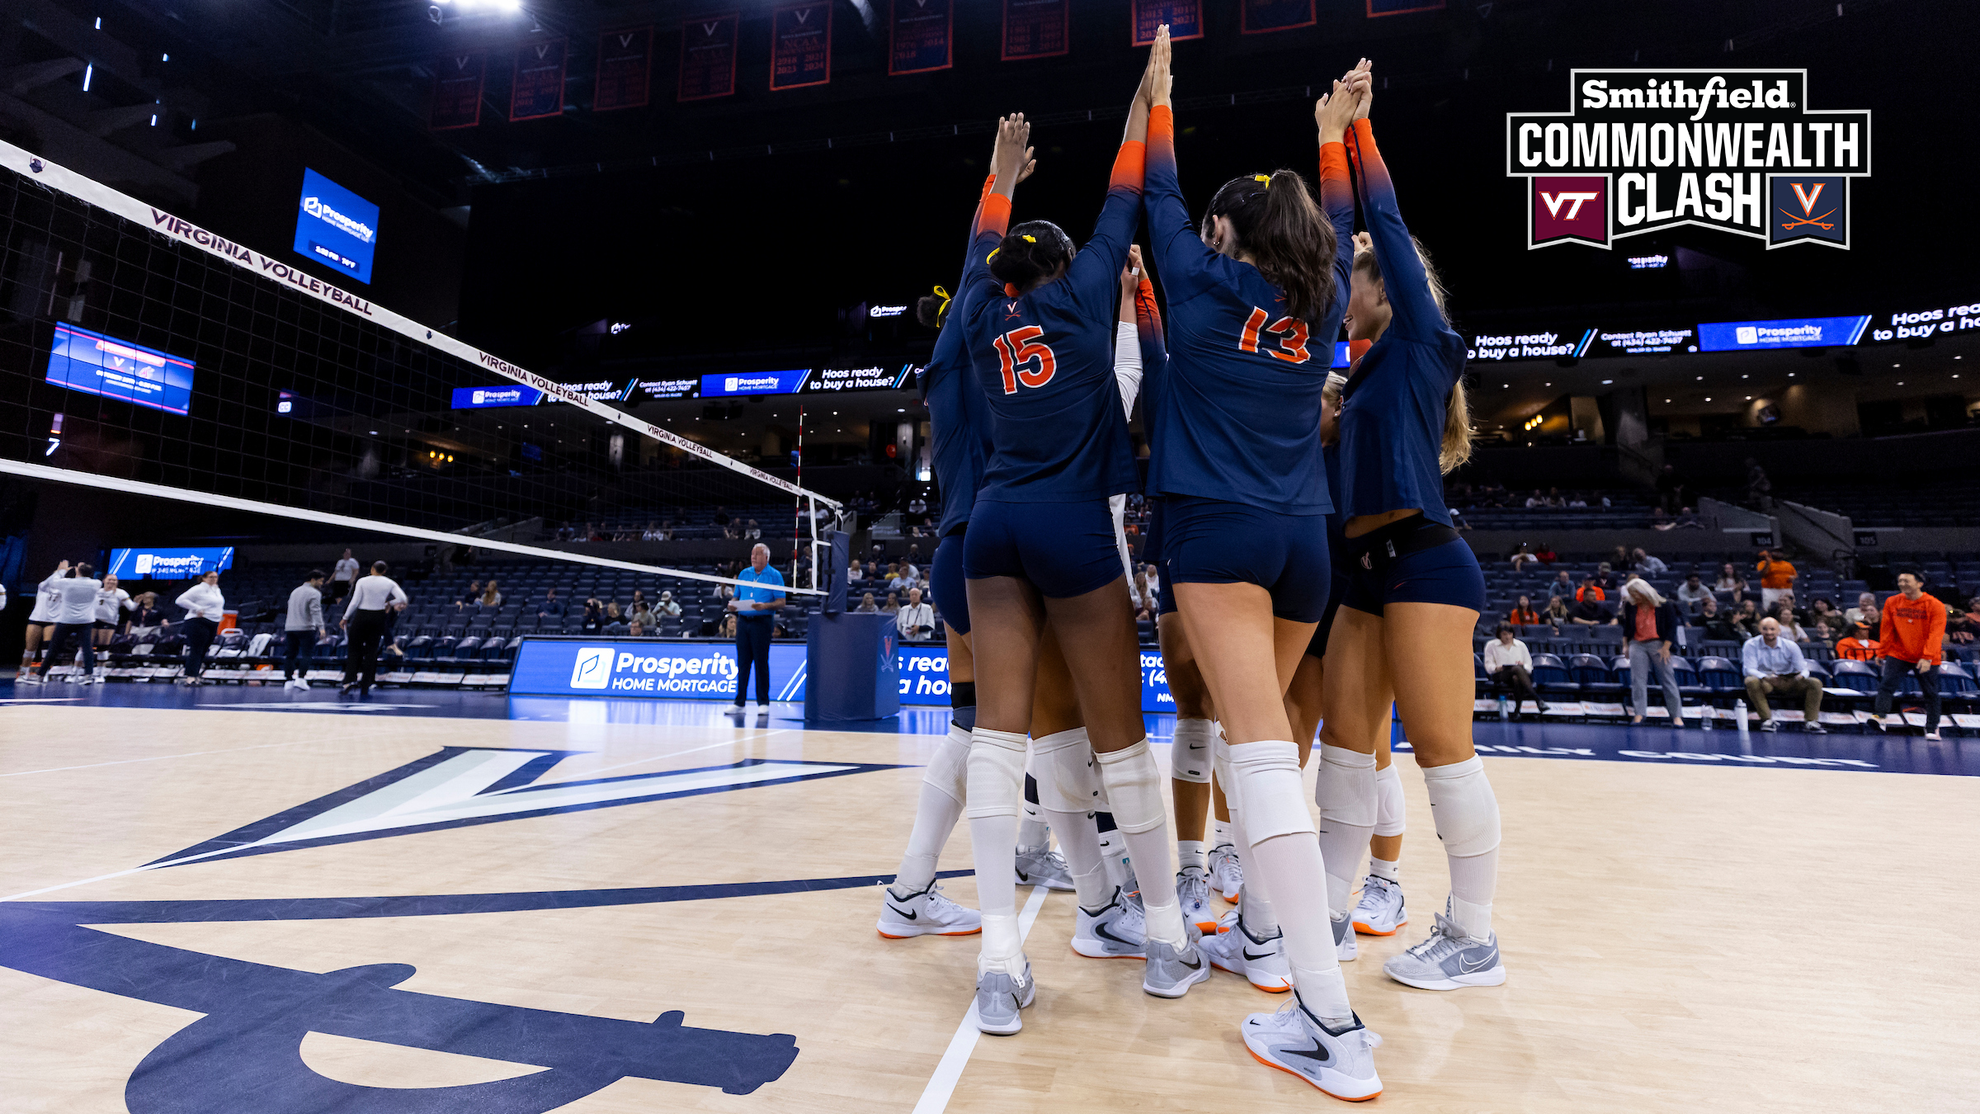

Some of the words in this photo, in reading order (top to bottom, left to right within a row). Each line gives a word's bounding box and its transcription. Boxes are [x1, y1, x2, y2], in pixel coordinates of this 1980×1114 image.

[322, 204, 374, 238] Prosperity
[150, 207, 253, 265] VIRGINIA
[259, 255, 372, 316] VOLLEYBALL
[1891, 308, 1943, 326] Hoos
[1948, 303, 1980, 318] rea
[1238, 305, 1312, 365] 13
[1475, 335, 1513, 348] Hoos
[1514, 331, 1558, 348] ready
[1600, 332, 1635, 341] Contact
[1635, 331, 1658, 341] Ryan
[1658, 329, 1692, 338] Schuett
[1758, 324, 1822, 338] Prosperity
[1759, 336, 1780, 344] HOME
[1781, 334, 1822, 343] MORTGAGE
[1872, 329, 1893, 341] to
[1897, 324, 1937, 341] buy
[1939, 321, 1955, 332] a
[992, 324, 1058, 396] 15
[1478, 346, 1507, 360] buy
[1508, 347, 1519, 358] a
[1521, 343, 1576, 357] house?
[479, 351, 527, 382] VIRGINIA
[531, 374, 588, 407] VOLLEYBALL
[822, 369, 849, 379] Hoos
[851, 366, 883, 378] ready
[583, 380, 613, 391] ready
[738, 376, 779, 387] Prosperity
[810, 380, 821, 390] to
[823, 379, 844, 391] buy
[845, 380, 853, 388] a
[855, 376, 895, 388] house?
[484, 389, 521, 399] Prosperity
[647, 425, 677, 444] VIRGINIA
[677, 436, 713, 458] VOLLEYBALL
[750, 467, 769, 481] VIRGINIA
[769, 475, 793, 490] VOLLEYBALL
[616, 652, 738, 680] Prosperity
[908, 657, 949, 672] rea
[612, 678, 654, 691] HOME
[657, 679, 737, 693] MORTGAGE
